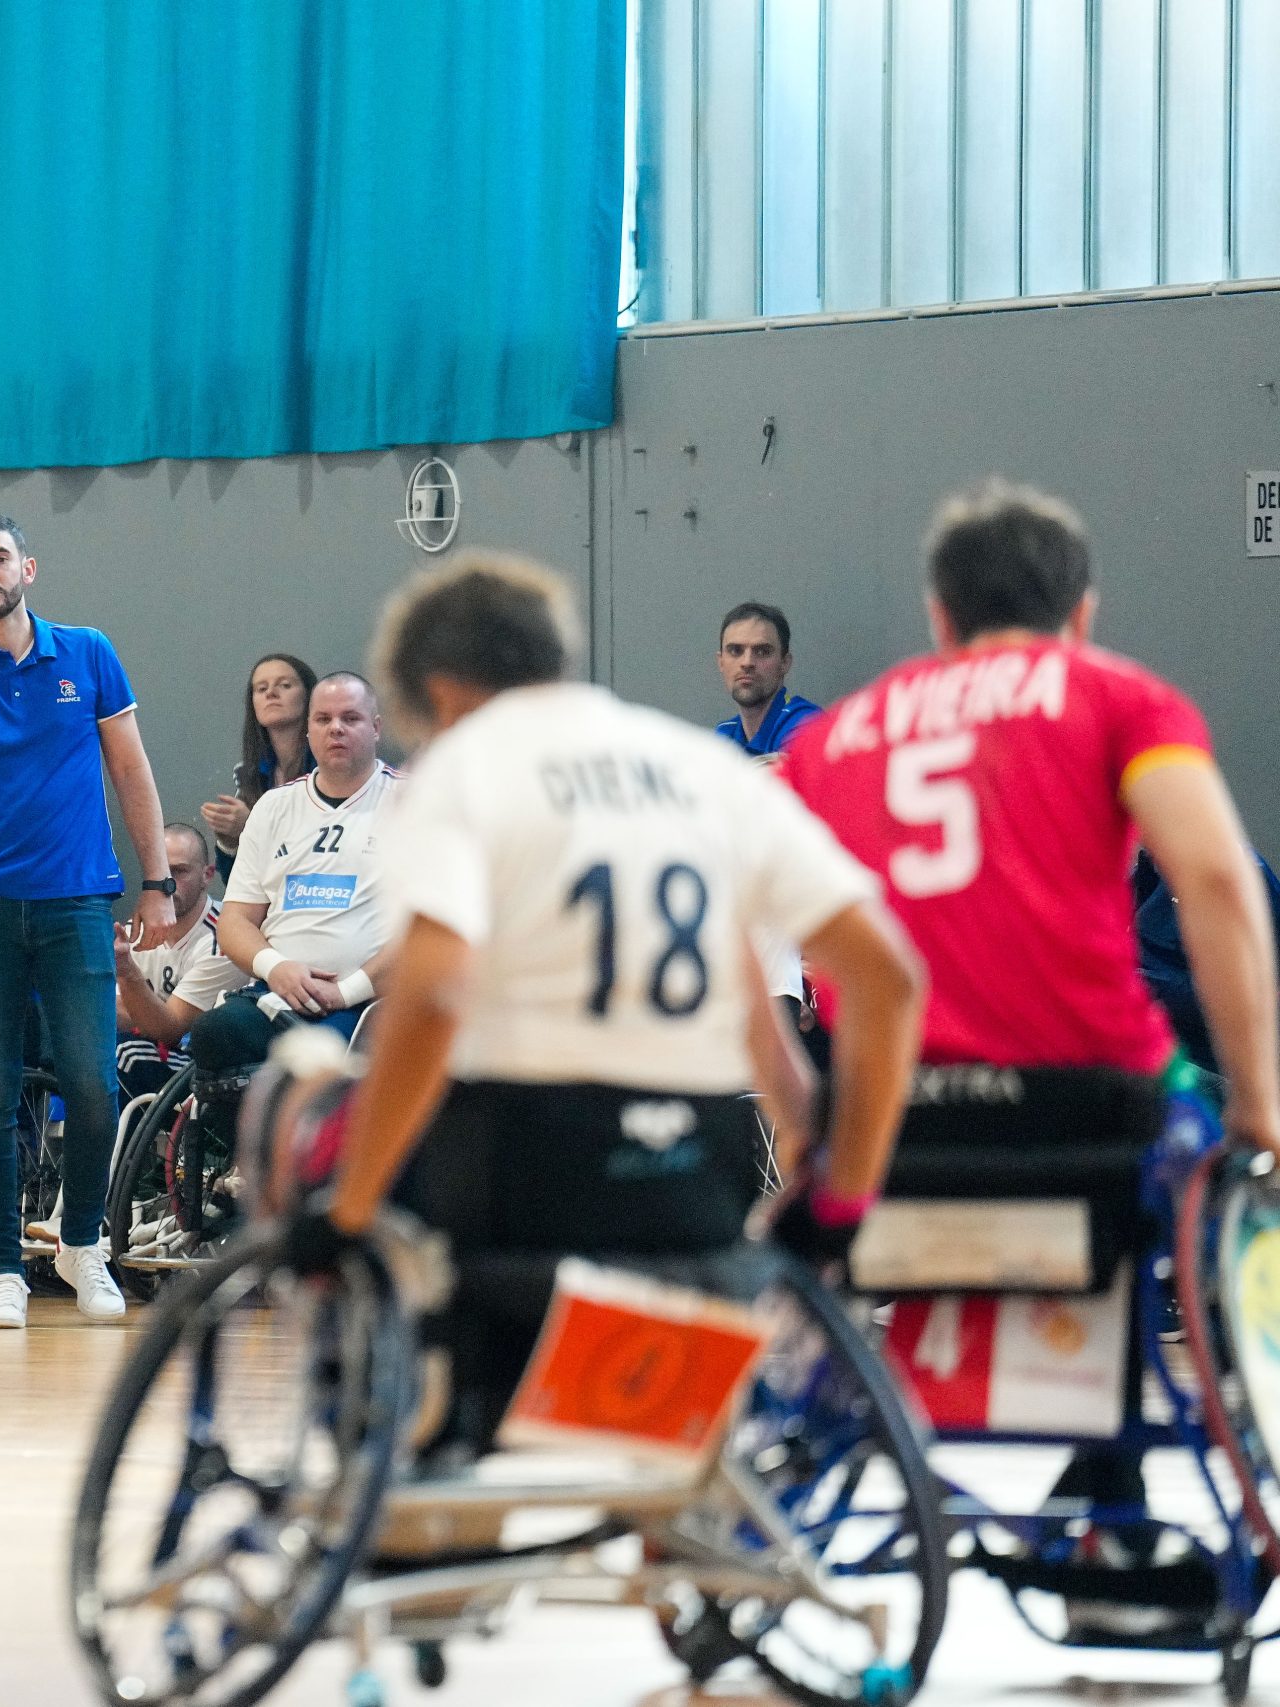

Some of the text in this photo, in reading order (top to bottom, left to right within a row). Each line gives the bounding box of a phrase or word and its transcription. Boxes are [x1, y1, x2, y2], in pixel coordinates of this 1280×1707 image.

[312, 824, 344, 853] 22
[884, 732, 985, 897] 5
[295, 884, 351, 899] Butagaz
[563, 861, 709, 1018] 18
